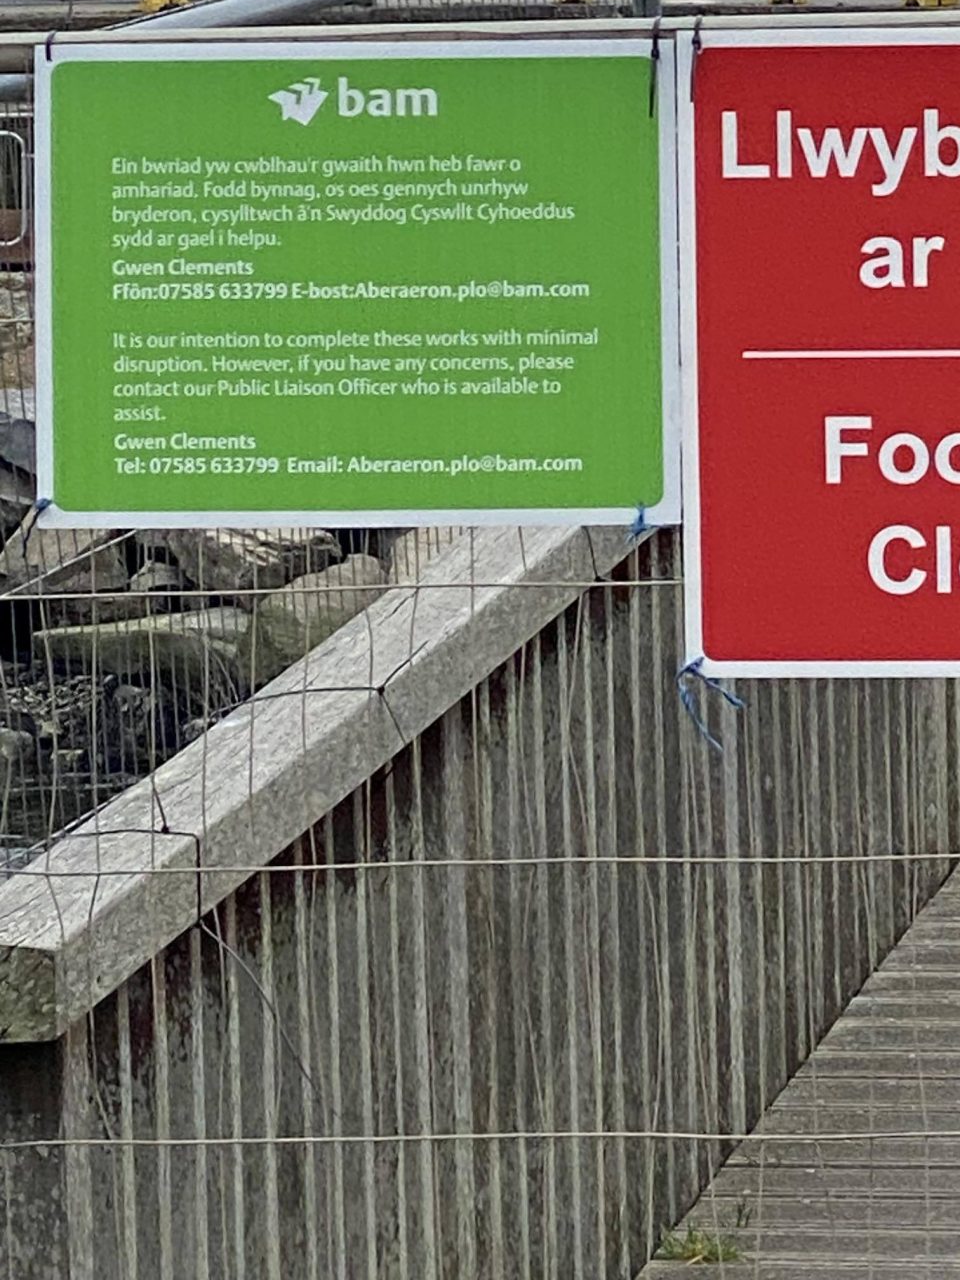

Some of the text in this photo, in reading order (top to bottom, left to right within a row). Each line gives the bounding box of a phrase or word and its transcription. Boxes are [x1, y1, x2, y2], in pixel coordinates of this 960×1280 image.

[336, 77, 438, 117] bam
[112, 154, 521, 177] Ein bwriad yw cwblhau'r gwaith hwn heb fawr o
[204, 180, 246, 198] Fodd
[325, 184, 344, 197] os
[349, 183, 379, 196] oes
[383, 178, 457, 201] gennych
[461, 179, 528, 199] unrhyw
[112, 206, 197, 227] bryderon,
[202, 205, 293, 226] cysylltwch
[326, 204, 406, 225] Swyddog
[411, 203, 473, 225] Cyswllt
[478, 202, 575, 224] Cyhoeddus
[112, 230, 152, 251] sydd
[157, 233, 174, 247] ar
[178, 229, 214, 250] gael
[228, 229, 282, 250] helpu.
[112, 259, 254, 275] Gwen Clements
[859, 235, 945, 289] ar
[219, 283, 288, 299] 633799
[113, 328, 598, 351] It is our intention to complete these works with minimal
[113, 352, 575, 376] disruption. However, if you have any concerns, please
[113, 377, 561, 397] contact our Public Liaison Officer who is available to
[114, 405, 166, 421] assist.
[114, 432, 256, 450] Gwen Clements
[115, 455, 583, 476] Tel: 07585 633799 Email: Aberaeron.plo@bam.com
